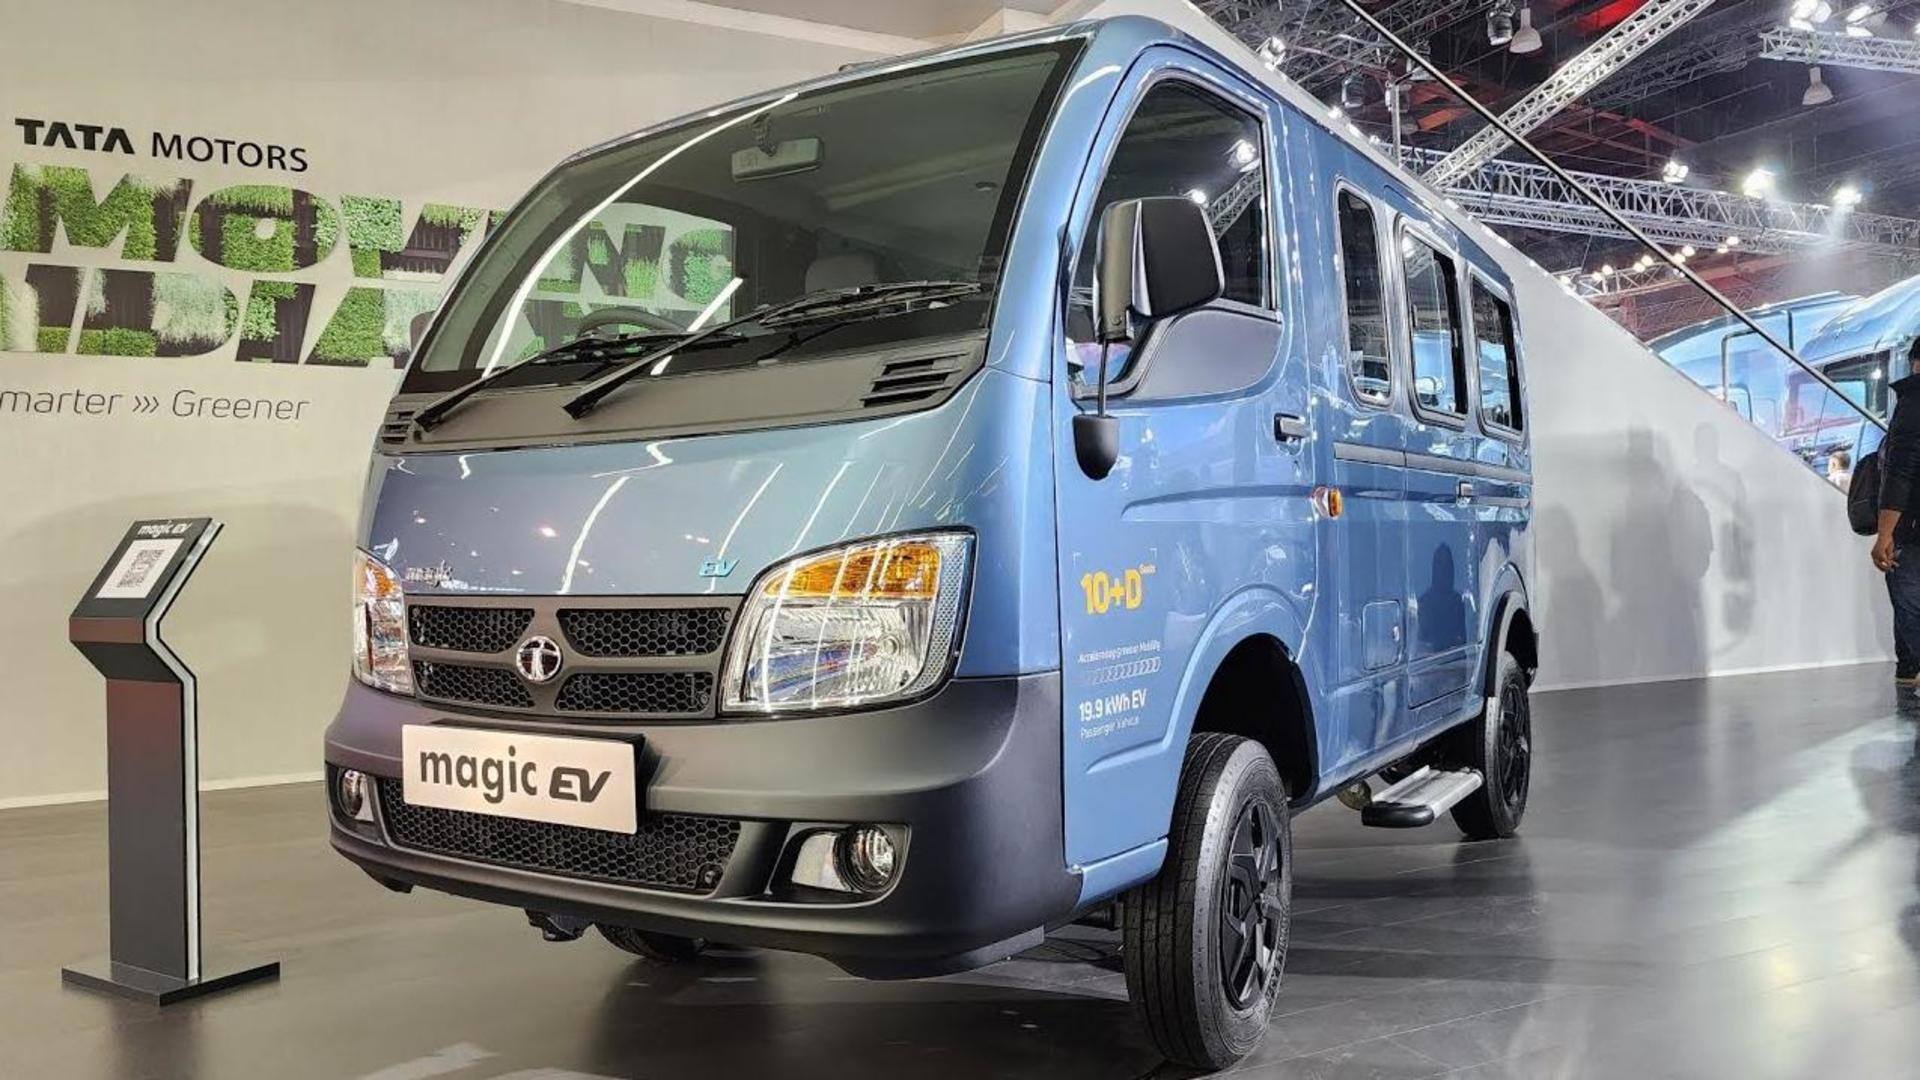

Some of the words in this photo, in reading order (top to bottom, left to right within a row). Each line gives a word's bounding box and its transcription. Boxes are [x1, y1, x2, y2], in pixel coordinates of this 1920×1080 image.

[15, 117, 135, 155] TATA
[151, 131, 309, 173] MOTORS
[171, 389, 309, 420] Greener
[138, 520, 174, 538] magic
[171, 522, 193, 534] EV
[699, 556, 741, 578] EV
[1081, 569, 1142, 615] 10+D
[1079, 698, 1104, 721] 19.9
[1105, 693, 1131, 716] kWh
[1131, 688, 1147, 709] EV
[419, 745, 537, 804] magic
[549, 766, 612, 804] EV
